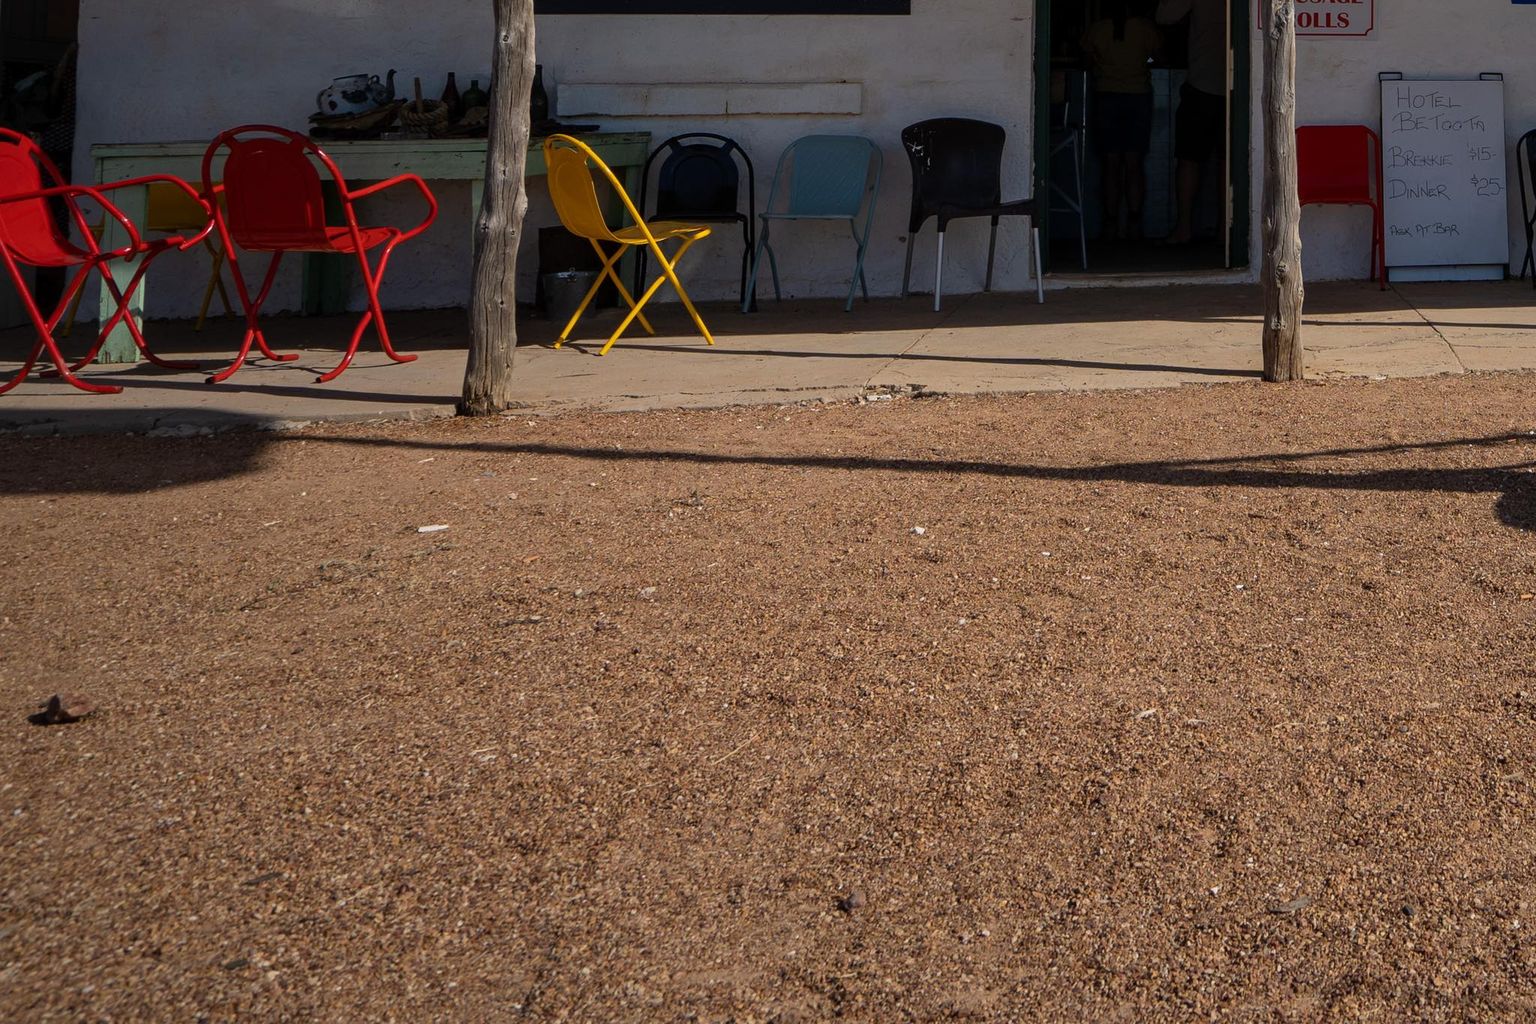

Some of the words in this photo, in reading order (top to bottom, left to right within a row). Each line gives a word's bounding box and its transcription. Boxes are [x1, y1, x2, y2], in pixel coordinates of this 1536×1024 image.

[1296, 12, 1350, 28] OLLS
[1396, 86, 1462, 109] HOTEL
[1388, 178, 1451, 200] DINNER
